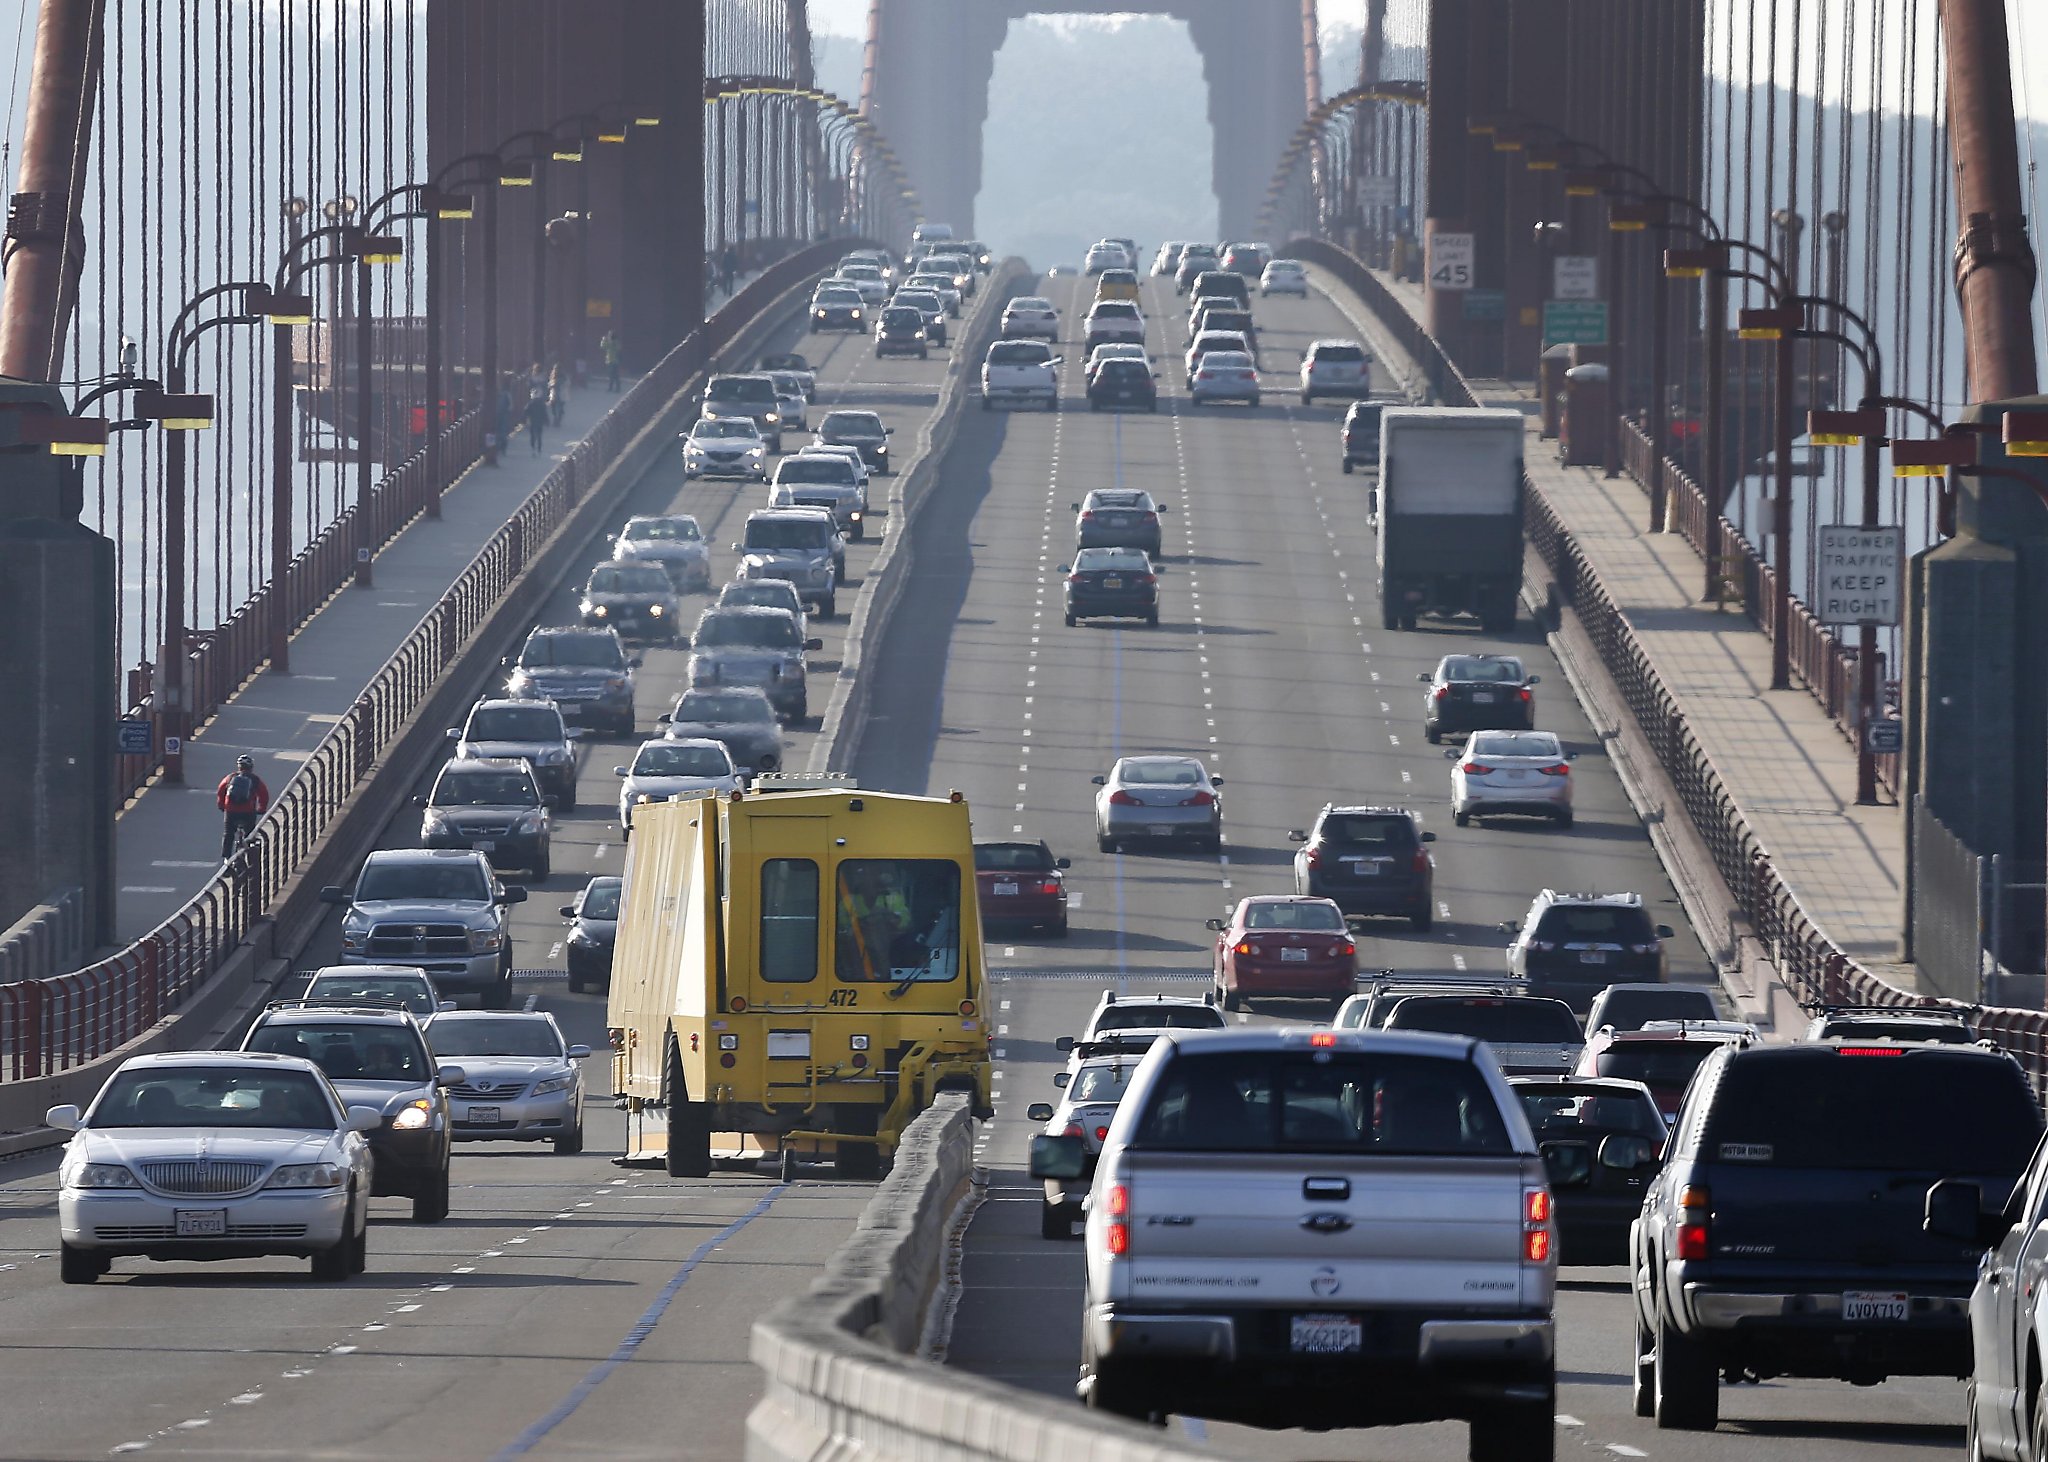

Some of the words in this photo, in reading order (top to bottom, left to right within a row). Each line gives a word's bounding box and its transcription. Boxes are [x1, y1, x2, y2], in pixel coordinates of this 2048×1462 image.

[1434, 237, 1470, 248] SPEED
[1437, 250, 1466, 260] LIMIT
[1432, 263, 1468, 284] 45
[1826, 536, 1894, 548] SLOWER
[1825, 554, 1893, 567] TRAFFIC
[1831, 575, 1886, 590] KEEP
[1828, 599, 1889, 614] RIGHT
[828, 989, 858, 1007] 472
[1736, 1245, 1776, 1254] TAHOE
